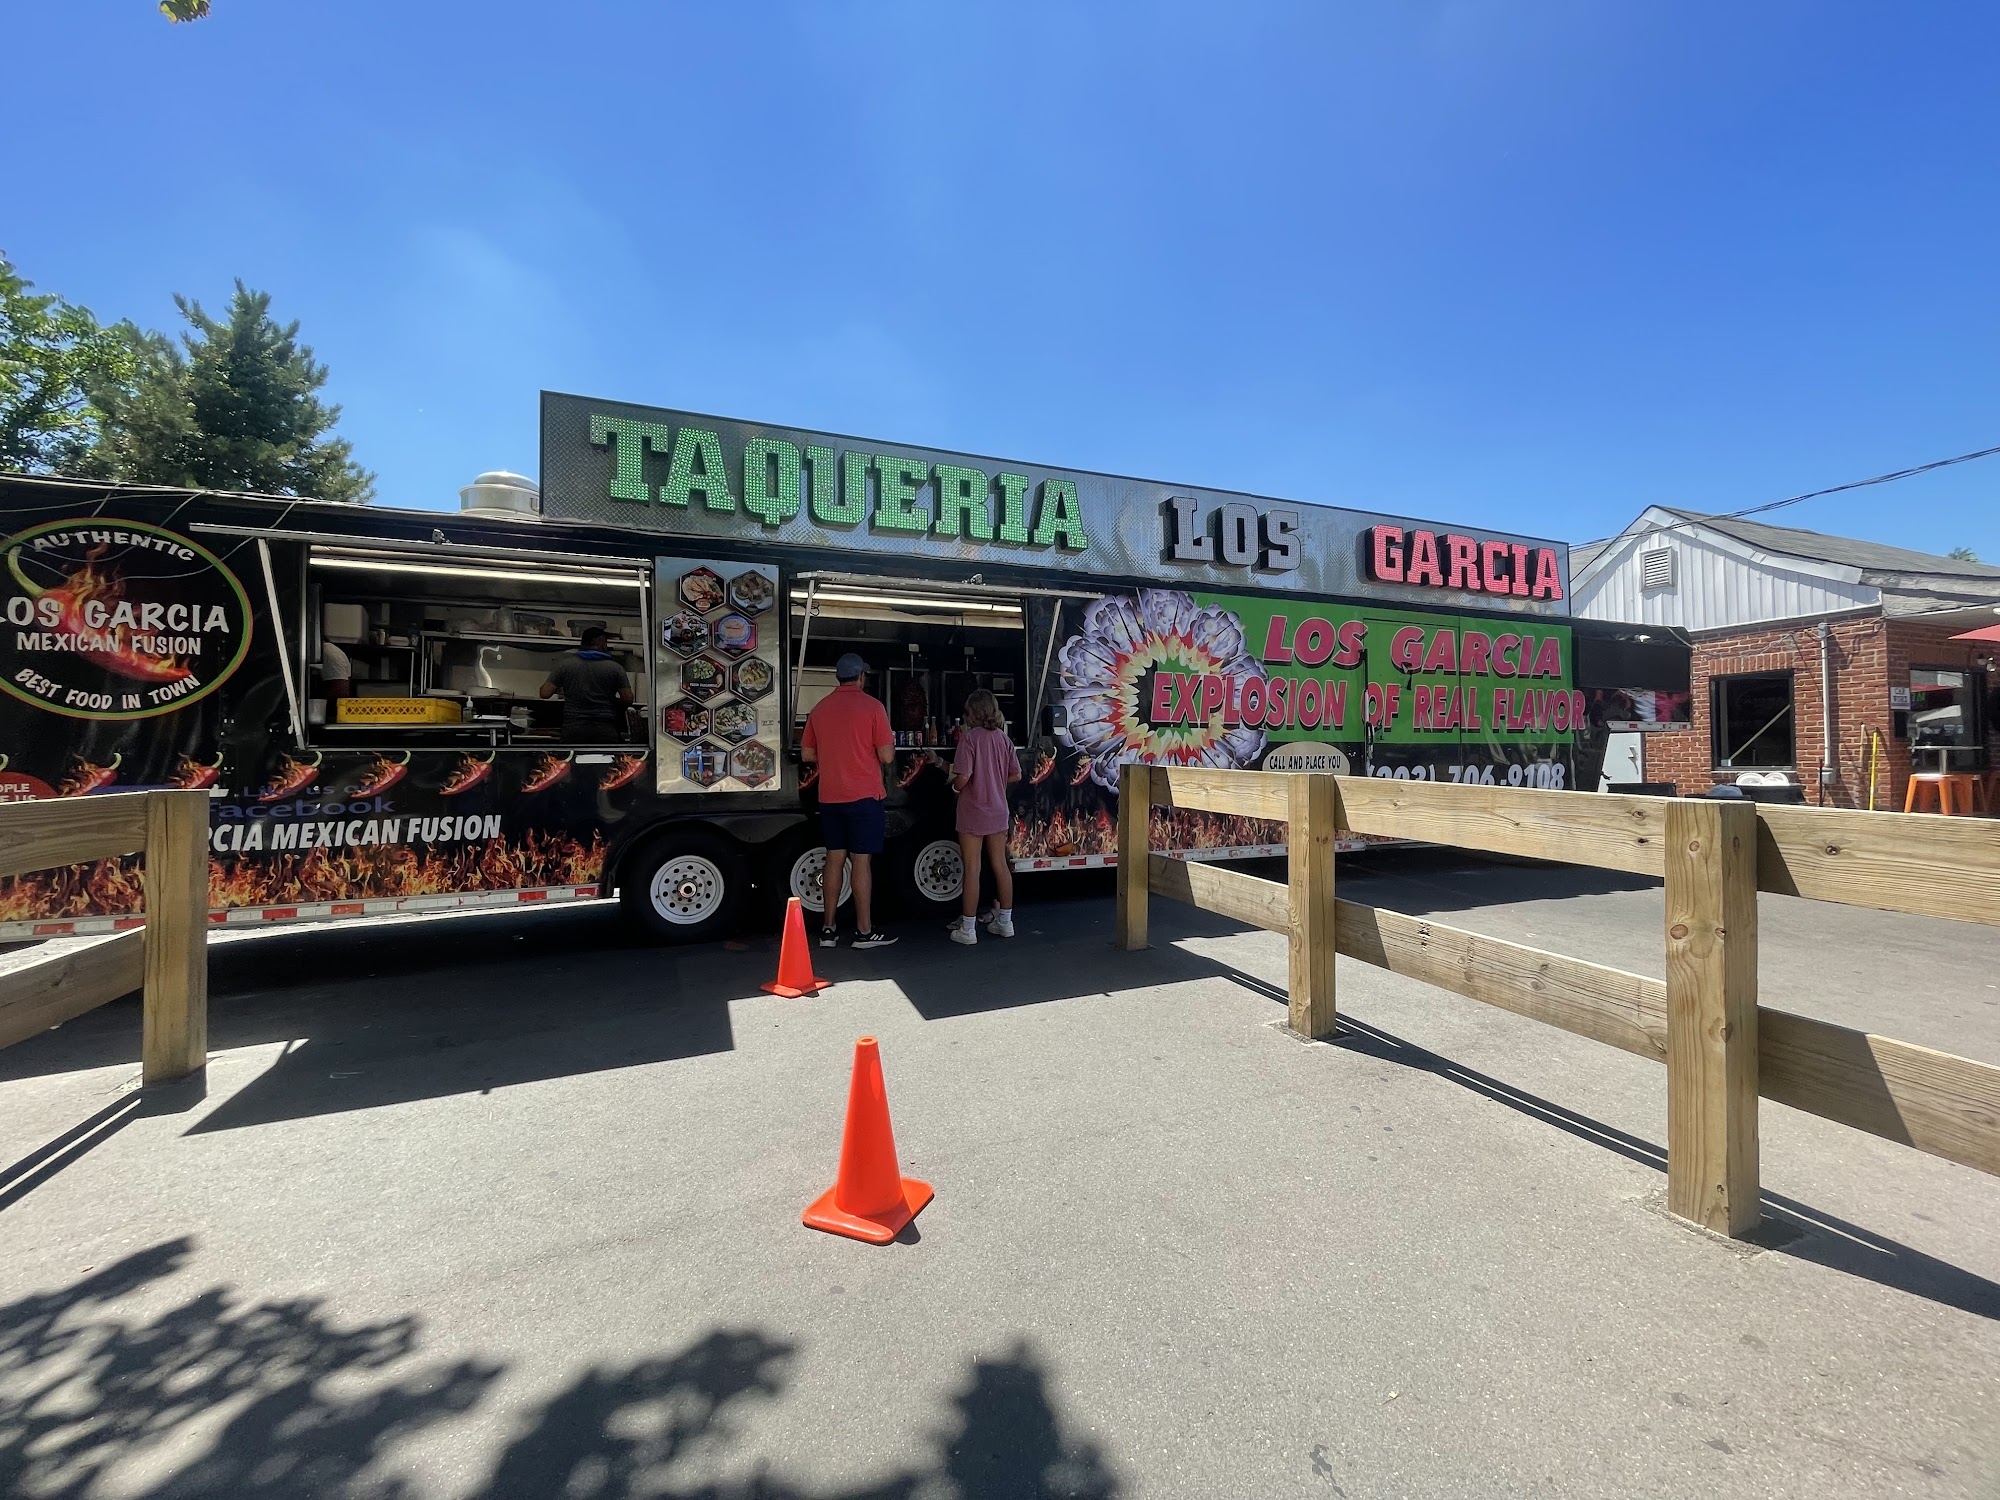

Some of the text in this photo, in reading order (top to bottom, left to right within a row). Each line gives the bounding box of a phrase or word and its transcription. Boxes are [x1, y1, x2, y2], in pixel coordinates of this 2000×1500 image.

[590, 413, 1564, 600] TAQUERIA LOS GARCIA
[33, 530, 195, 561] AUTHENTIC
[0, 596, 230, 634] OS GARCIA
[17, 631, 201, 656] MEXICAN FUSION
[1264, 615, 1563, 679] LOS GARCIA
[14, 667, 201, 711] BEST FOOD IN TOWN
[1150, 671, 1587, 733] EXPLOSION OF REAL FLAVOR
[1269, 755, 1341, 770] CALL AND PLACE YOU
[207, 814, 502, 852] CIA MEXICAN FUSION
